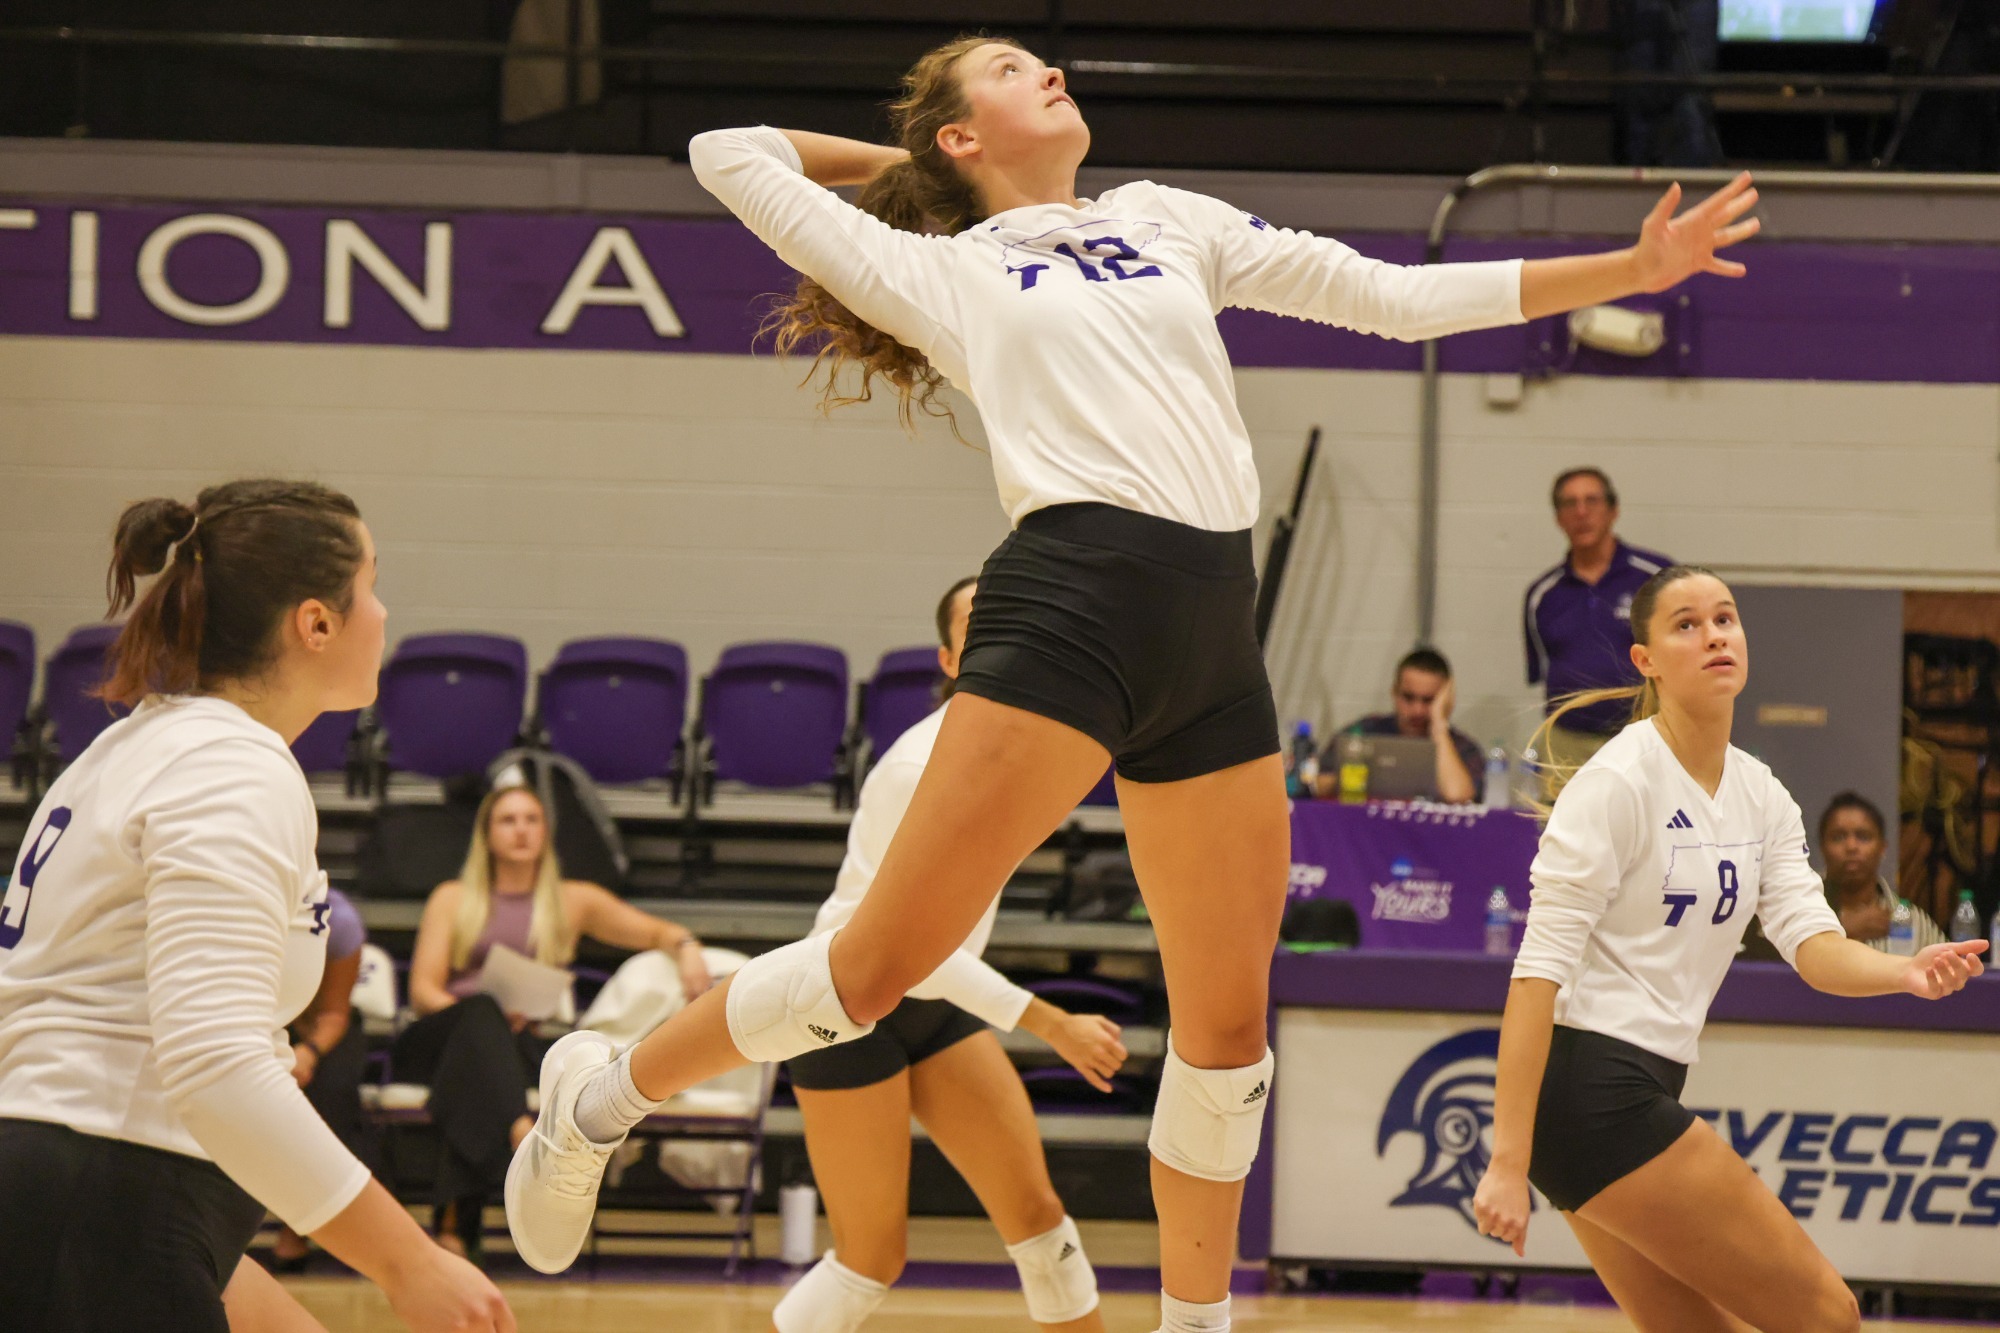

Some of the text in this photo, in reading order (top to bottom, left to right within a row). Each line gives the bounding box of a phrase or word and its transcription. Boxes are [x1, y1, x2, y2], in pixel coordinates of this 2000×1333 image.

[1054, 236, 1164, 282] 12
[0, 806, 72, 950] 9
[1662, 860, 1739, 927] T 8
[1752, 1167, 2000, 1227] ETICS
